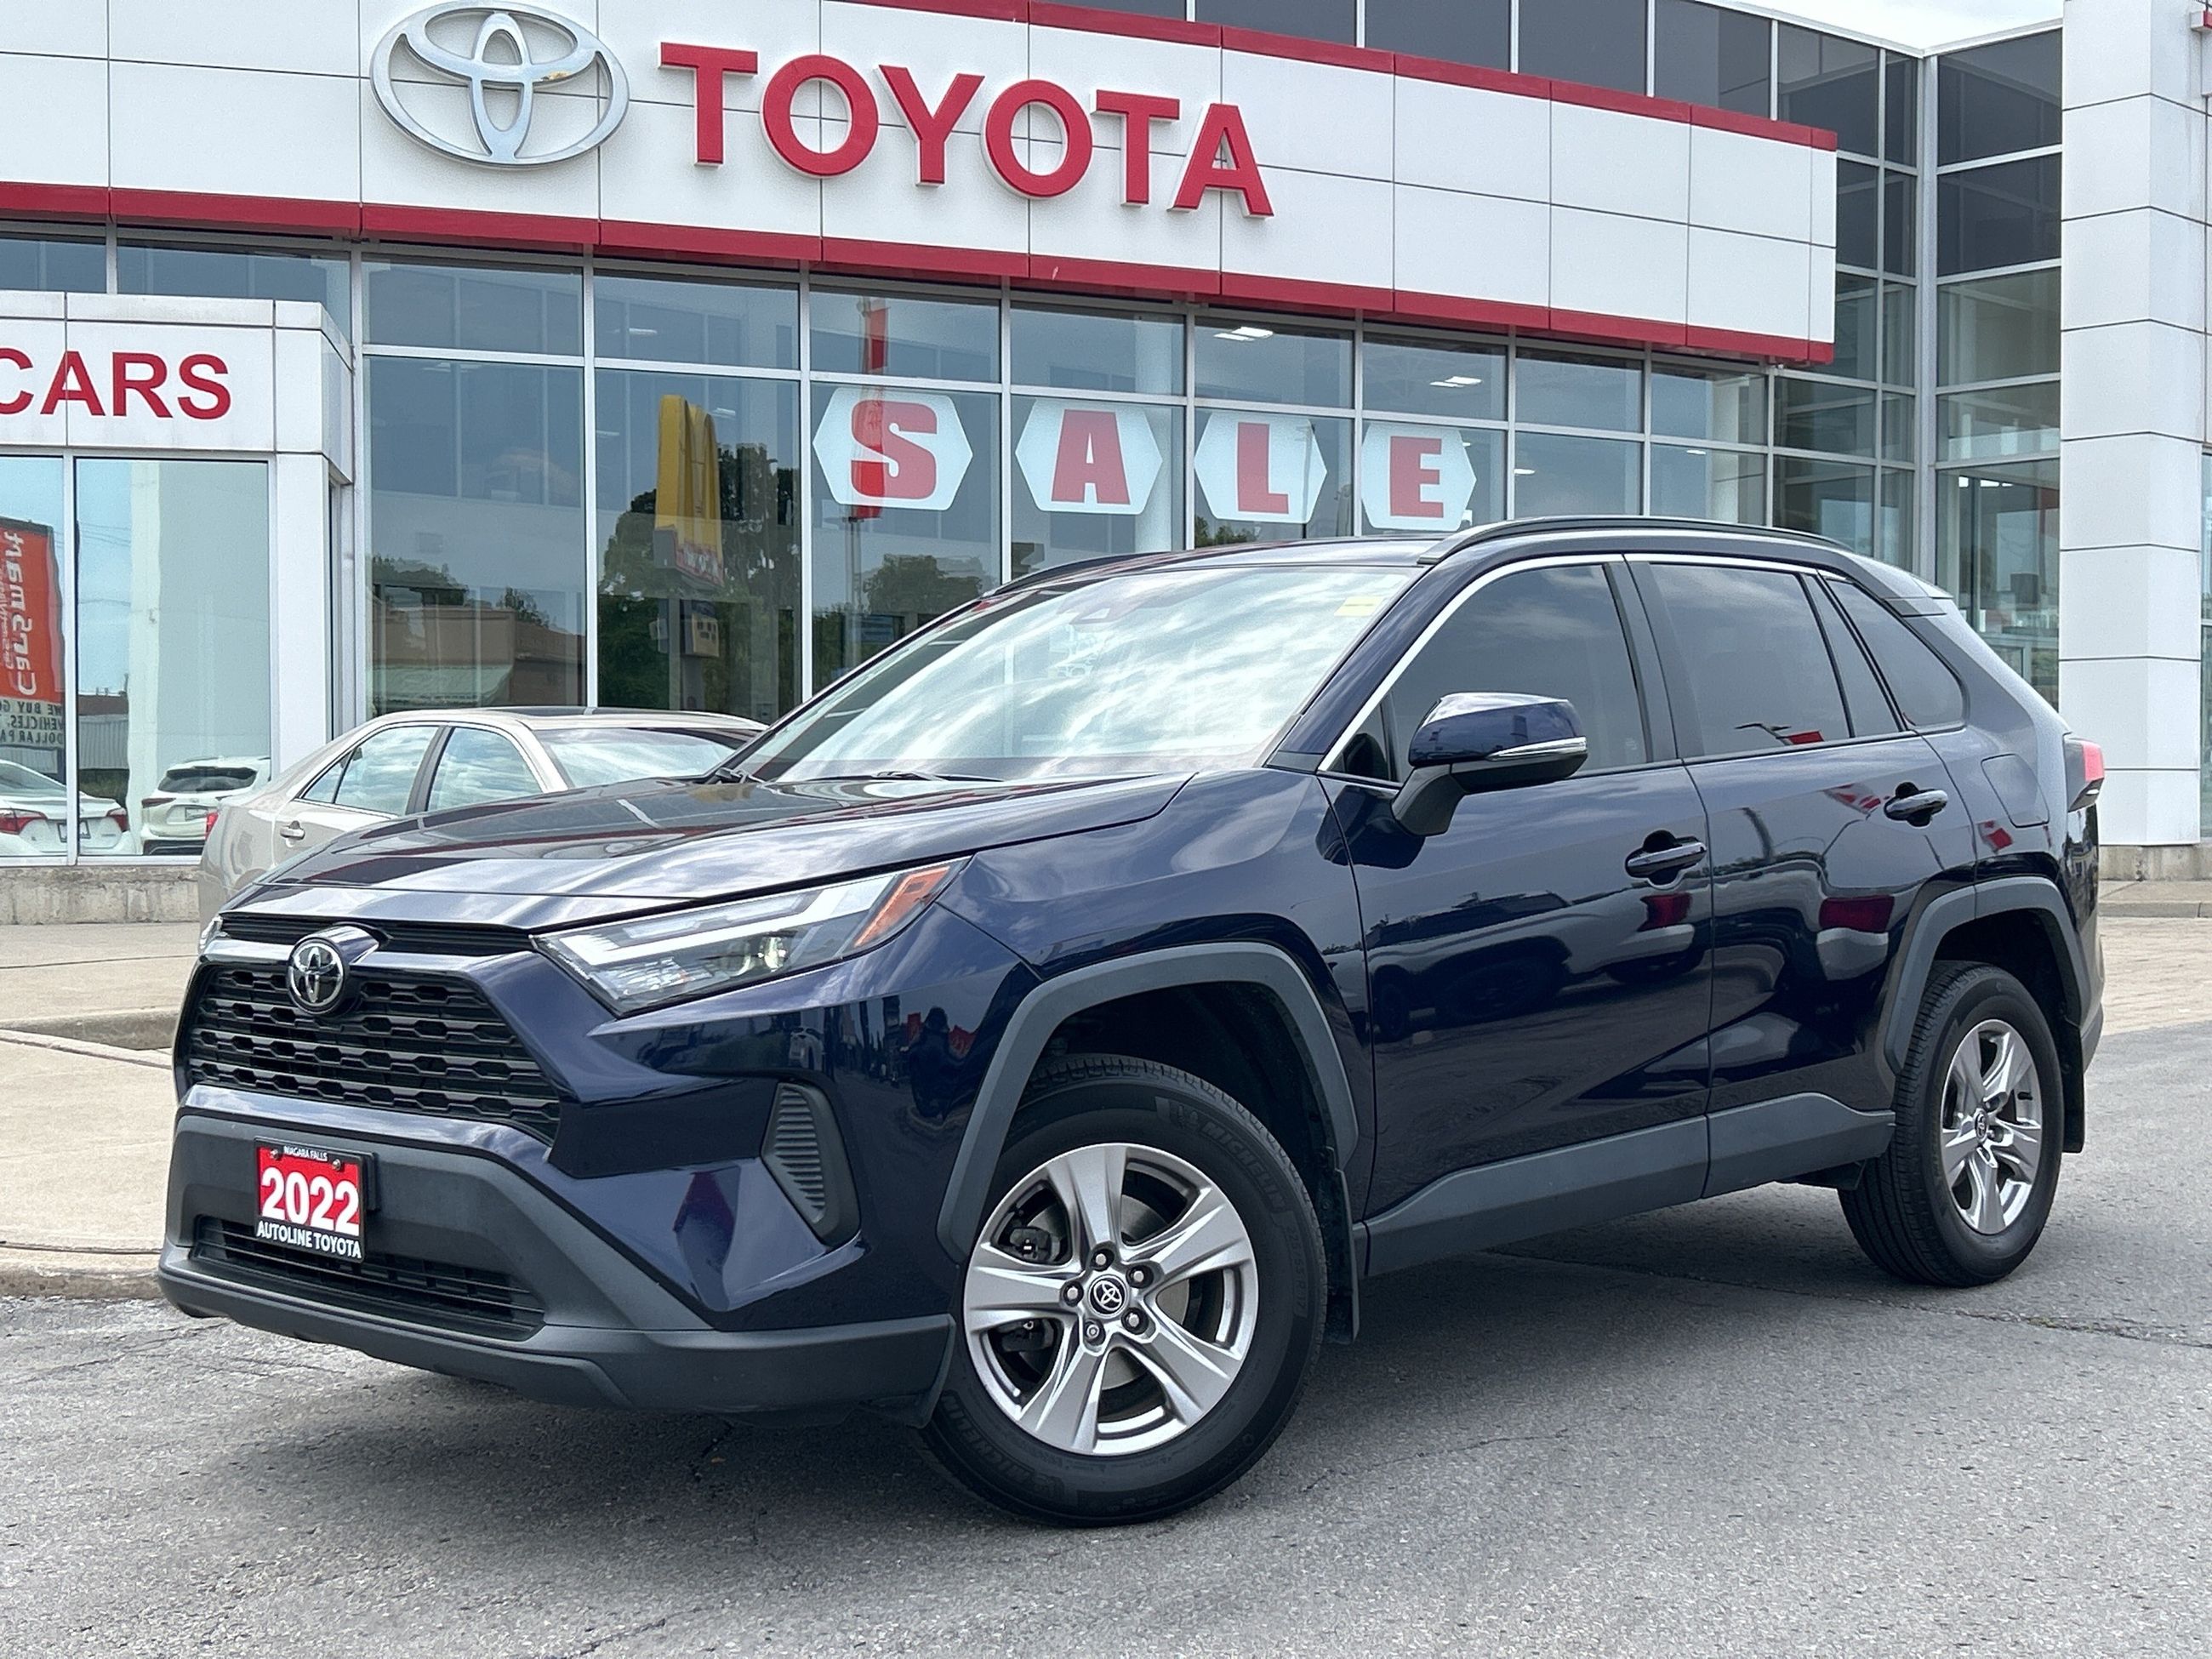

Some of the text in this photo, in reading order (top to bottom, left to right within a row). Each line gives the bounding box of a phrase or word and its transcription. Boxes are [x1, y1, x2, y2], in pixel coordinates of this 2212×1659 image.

[659, 41, 1274, 218] TOYOTA
[851, 399, 1445, 519] SALE
[283, 1145, 328, 1162] NIAGARA FALLS
[1200, 1120, 1287, 1211] MICHELIN
[256, 1220, 362, 1258] AUTOLINE TOYOTA
[261, 1166, 360, 1236] 2022
